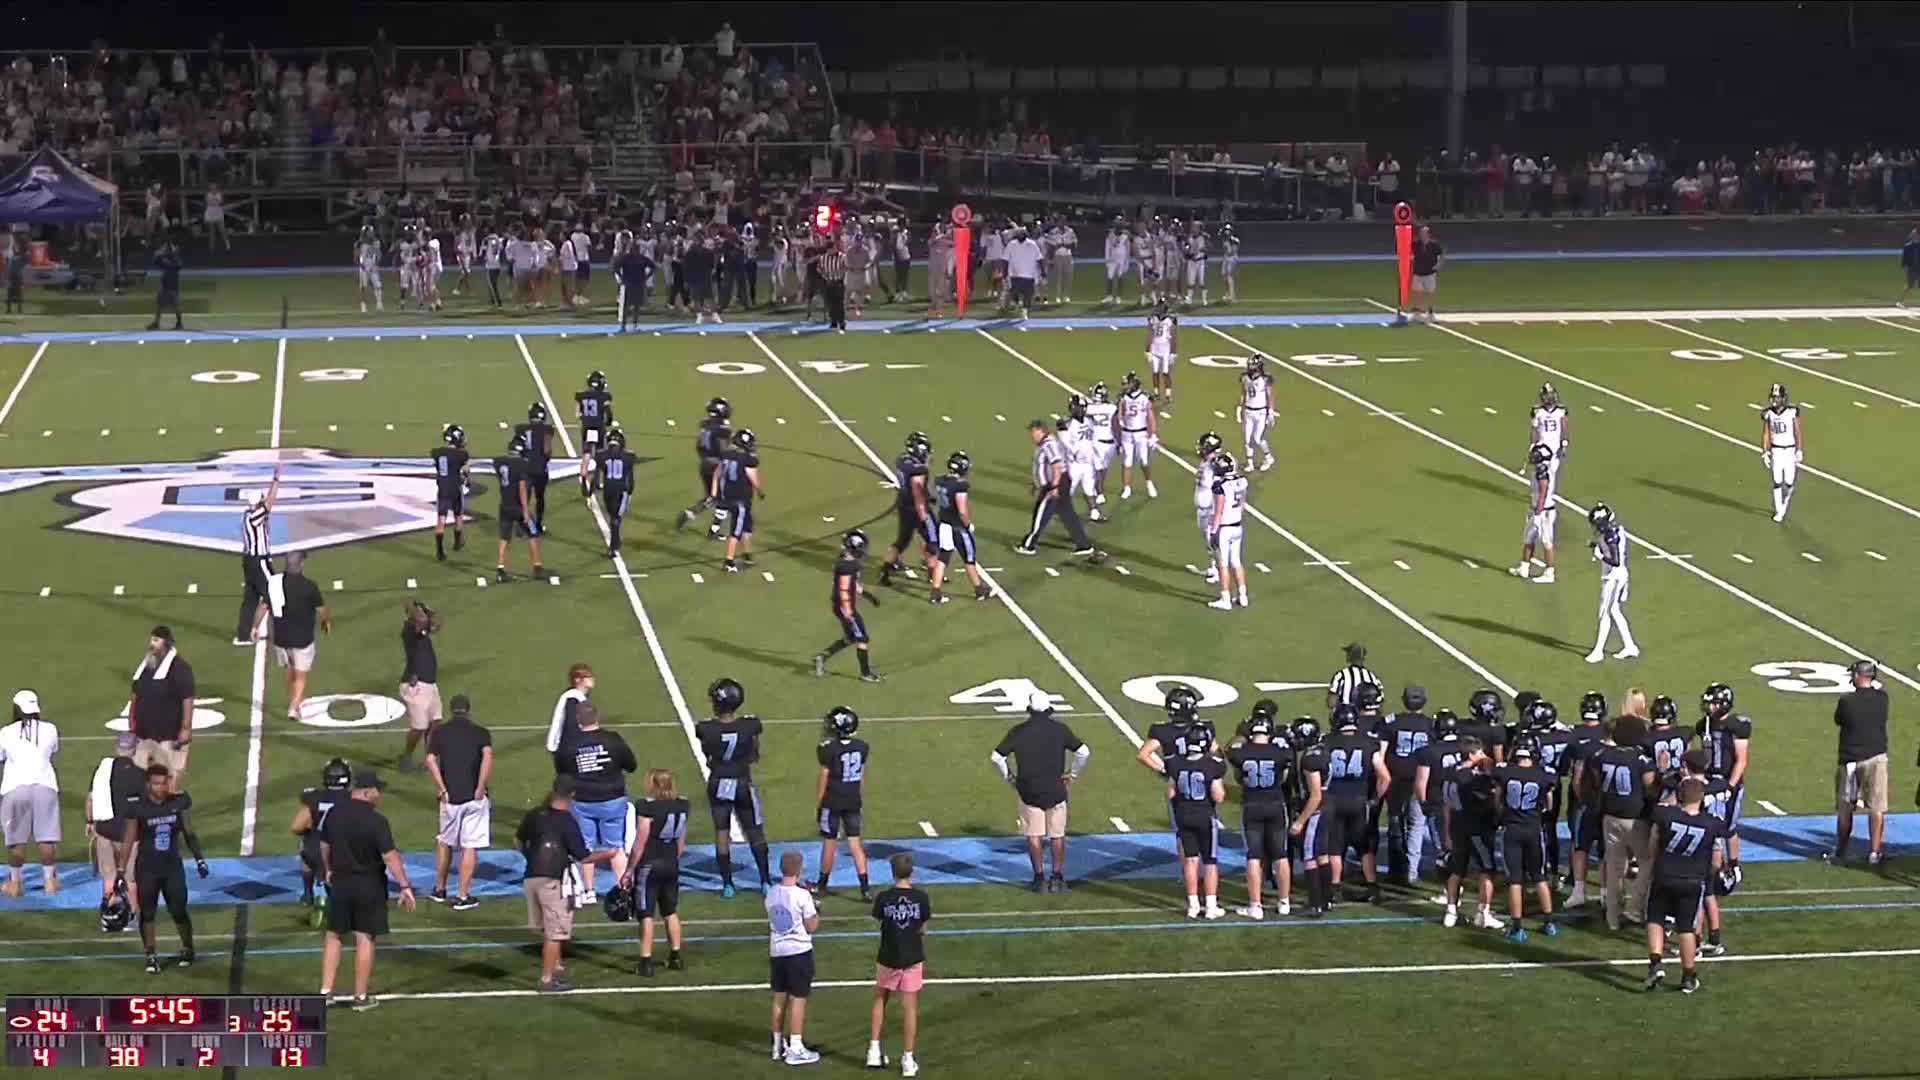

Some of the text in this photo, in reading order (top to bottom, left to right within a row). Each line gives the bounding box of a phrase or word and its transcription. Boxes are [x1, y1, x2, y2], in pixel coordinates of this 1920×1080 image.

[816, 205, 830, 227] 2
[582, 399, 598, 417] 13
[1544, 419, 1557, 432] 13
[605, 458, 623, 479] 10
[950, 678, 1239, 711] 40
[721, 732, 738, 761] 7
[841, 751, 861, 782] 12
[1242, 760, 1275, 788] 35
[1330, 749, 1363, 778] 64
[1602, 763, 1632, 796] 70
[1665, 821, 1706, 857] 77
